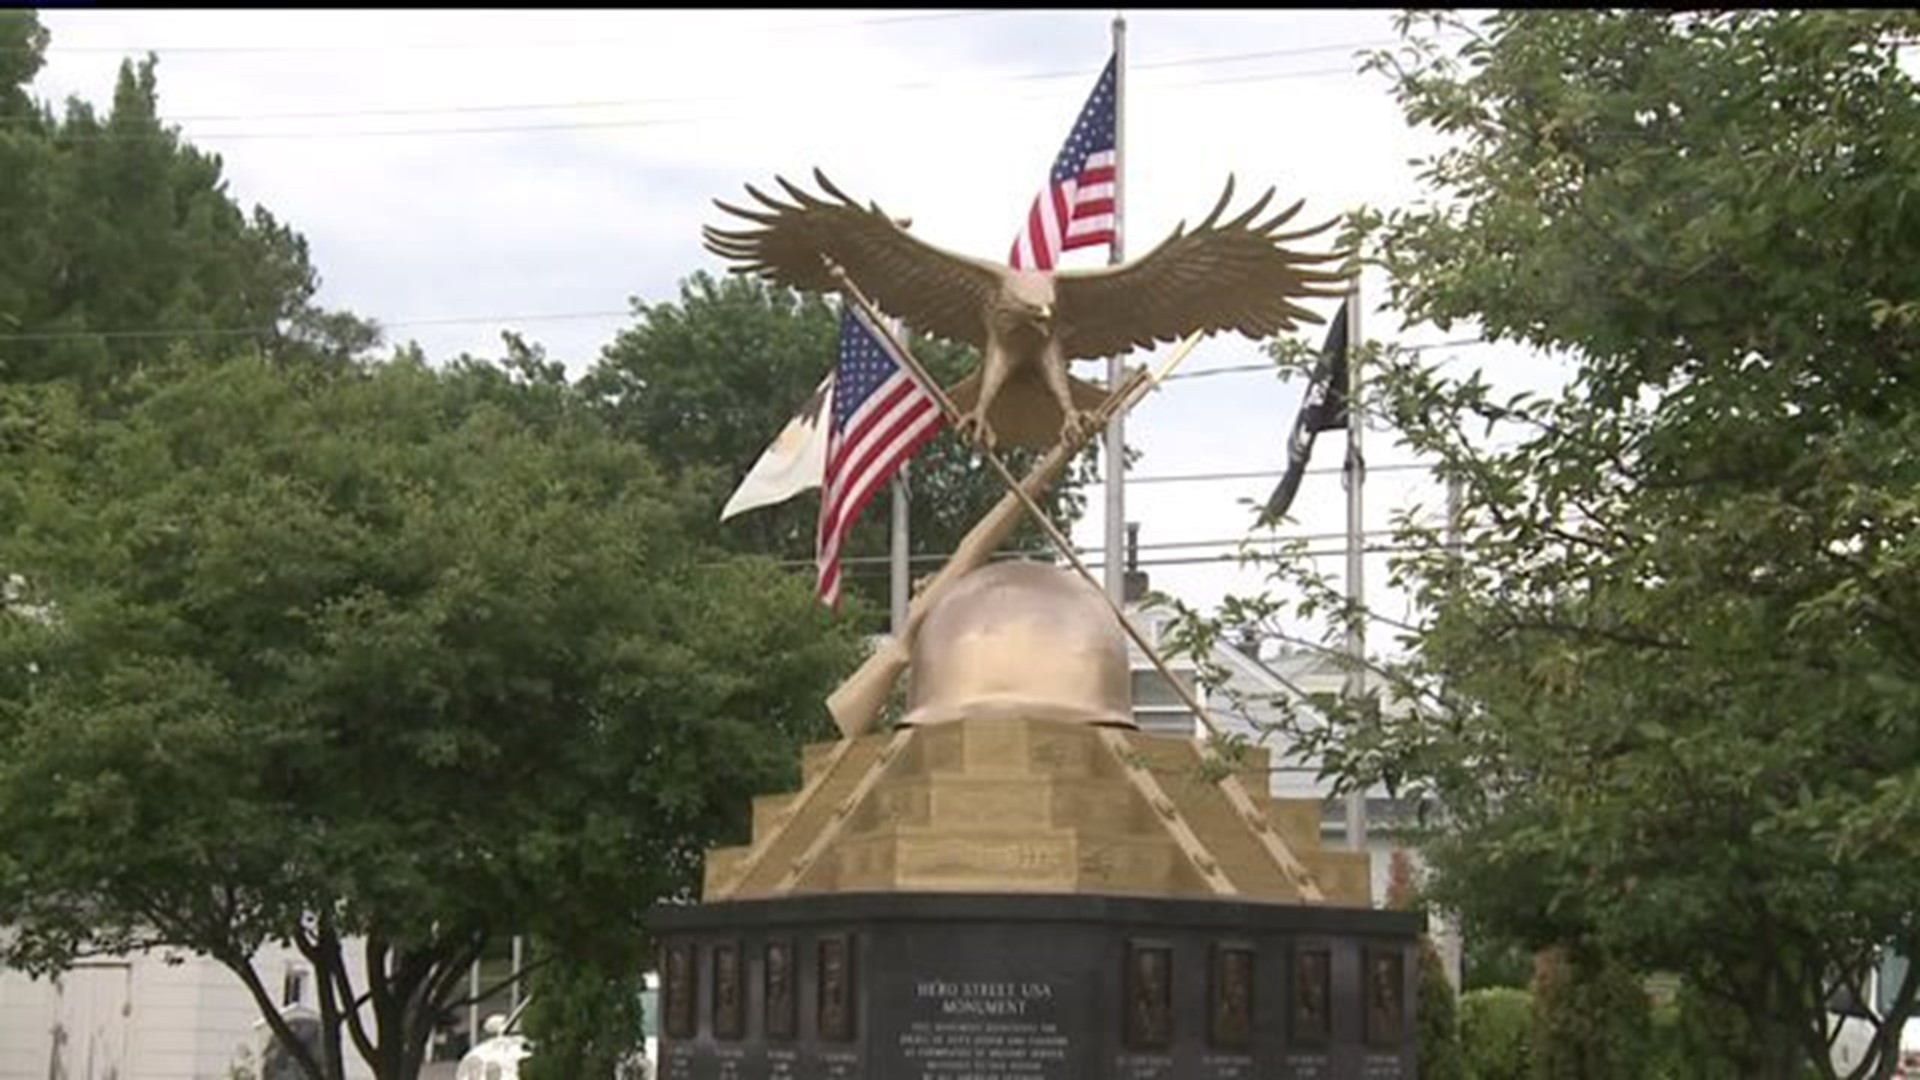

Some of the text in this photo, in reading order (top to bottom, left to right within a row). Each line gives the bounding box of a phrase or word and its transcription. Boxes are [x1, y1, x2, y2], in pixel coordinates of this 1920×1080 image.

[917, 983, 1052, 998] HERO STREET USA
[943, 1000, 1026, 1015] MONUMENT
